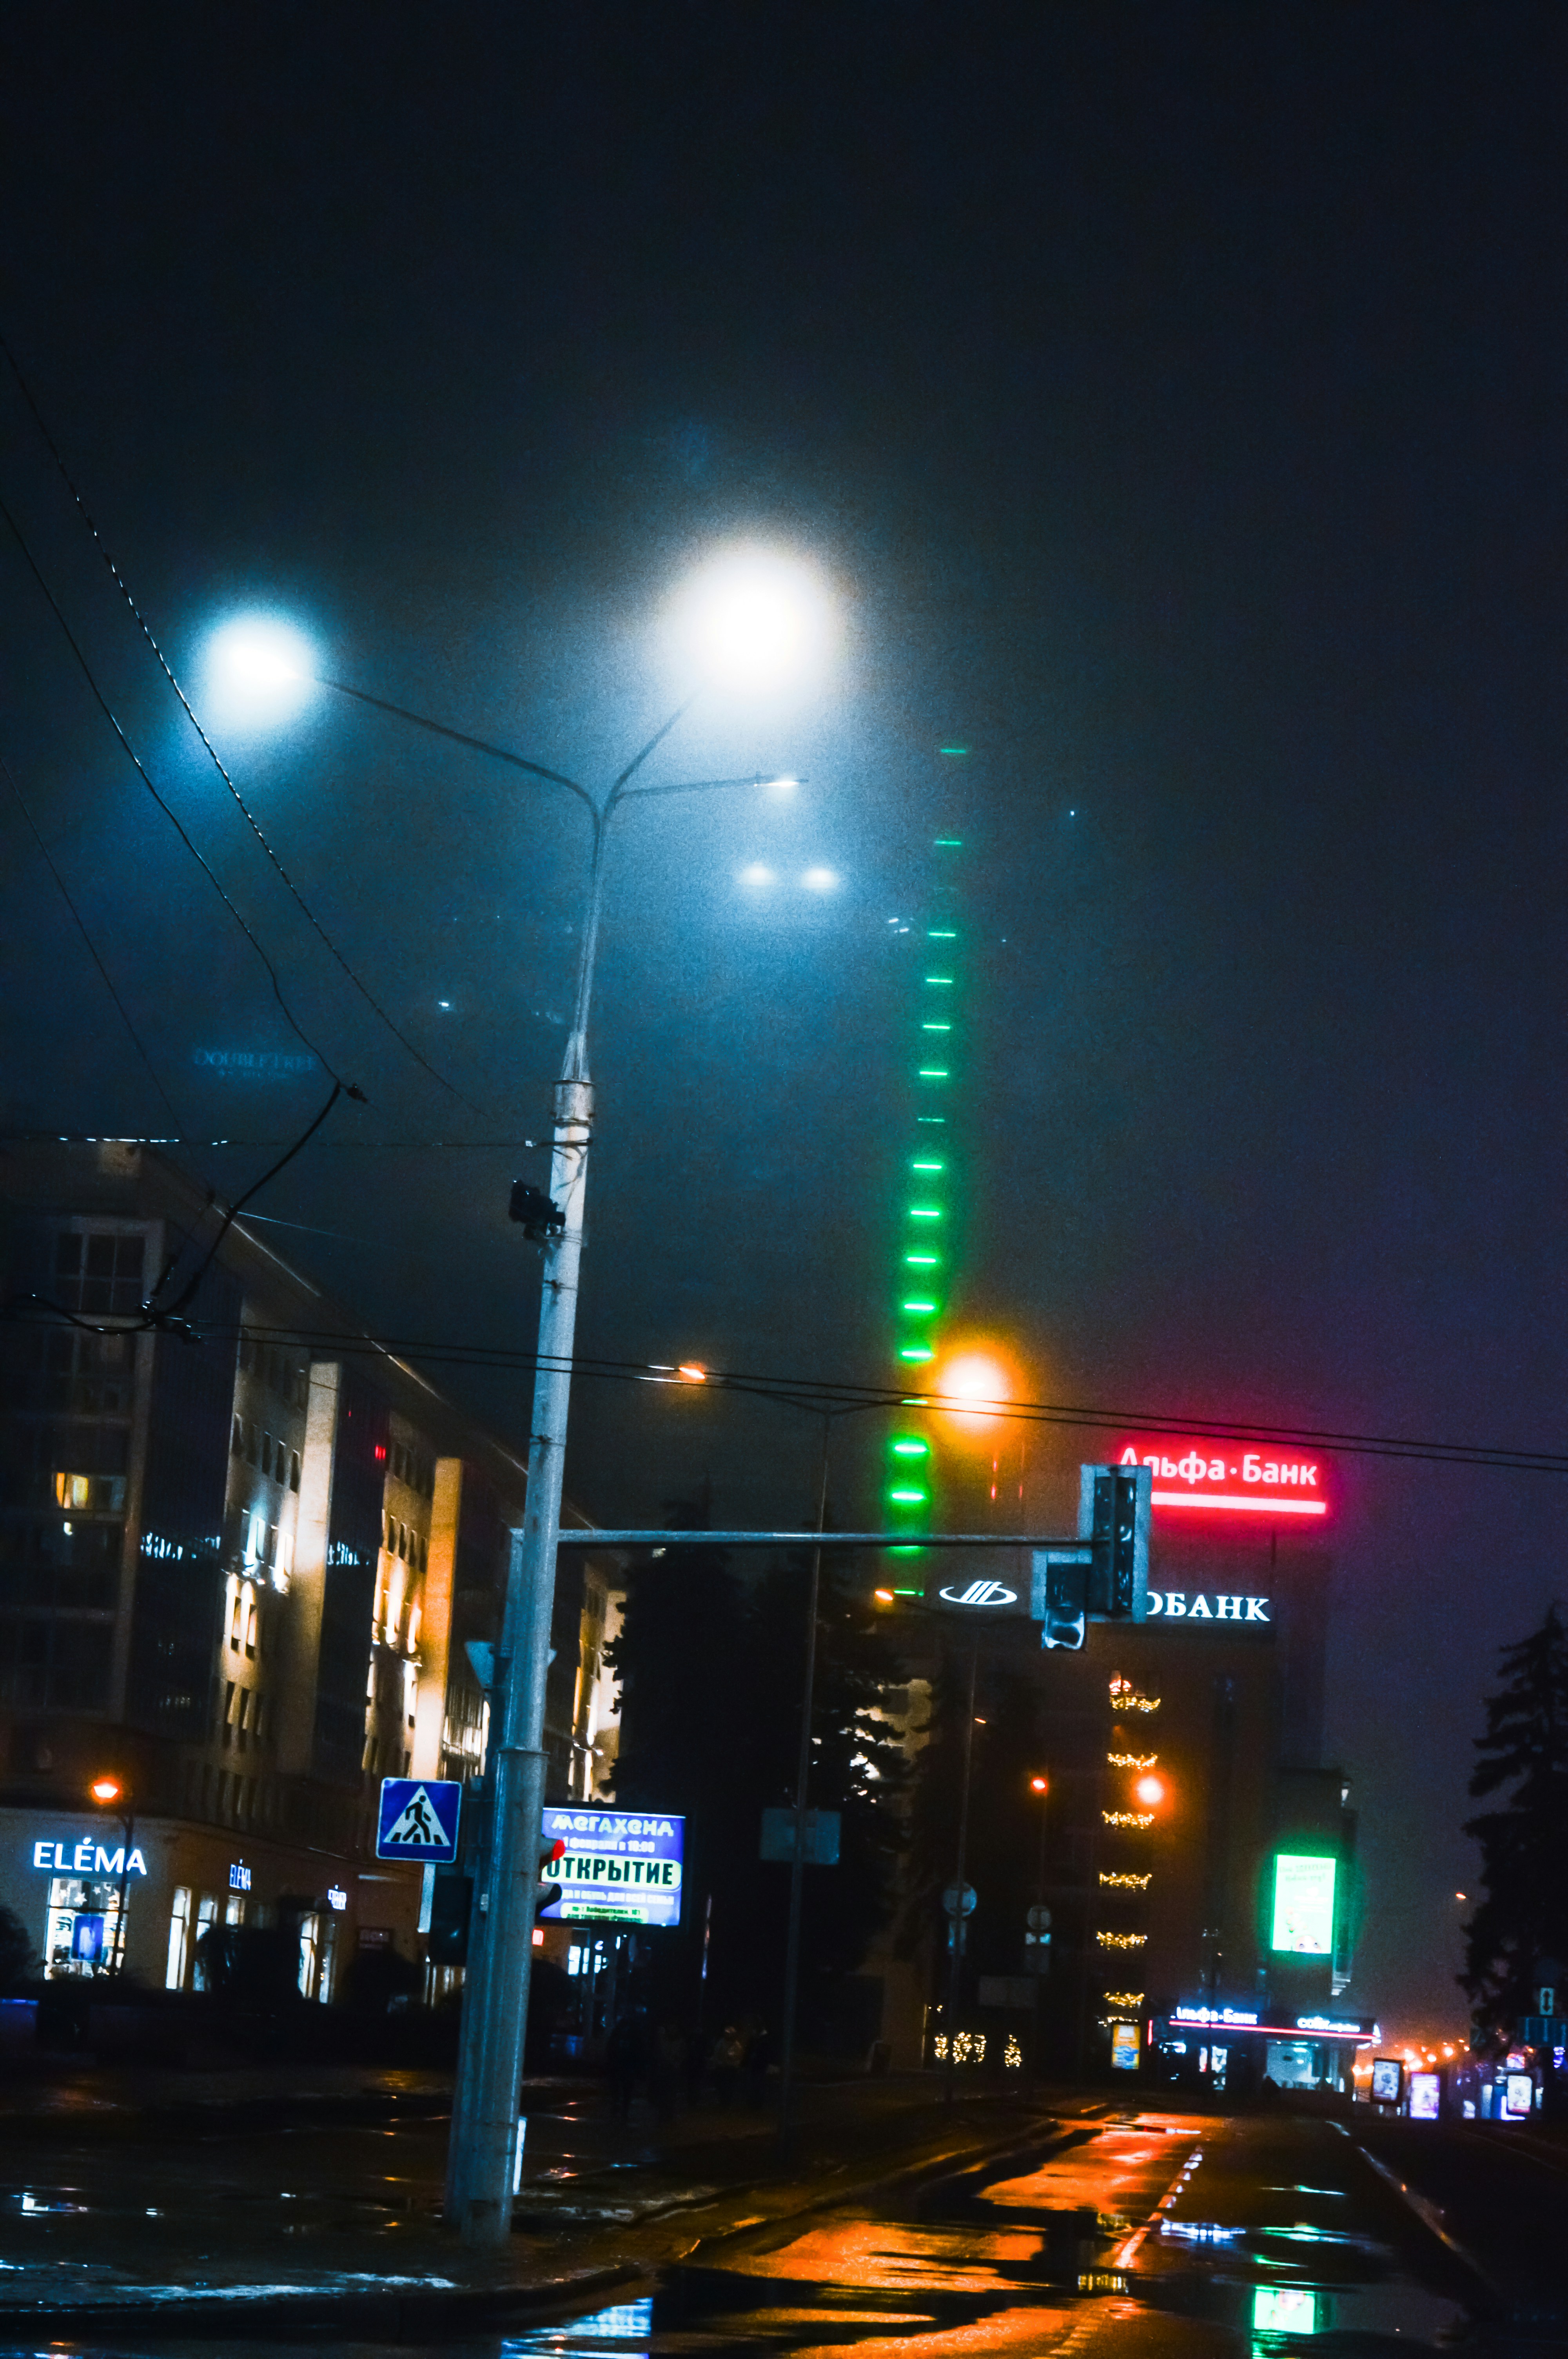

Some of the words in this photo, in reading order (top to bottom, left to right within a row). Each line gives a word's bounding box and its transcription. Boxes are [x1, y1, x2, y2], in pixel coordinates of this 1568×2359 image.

[34, 1837, 147, 1875] ELÉMA
[628, 1840, 655, 1853] 10:00
[547, 1857, 673, 1885] ОТКРЫТИЕ
